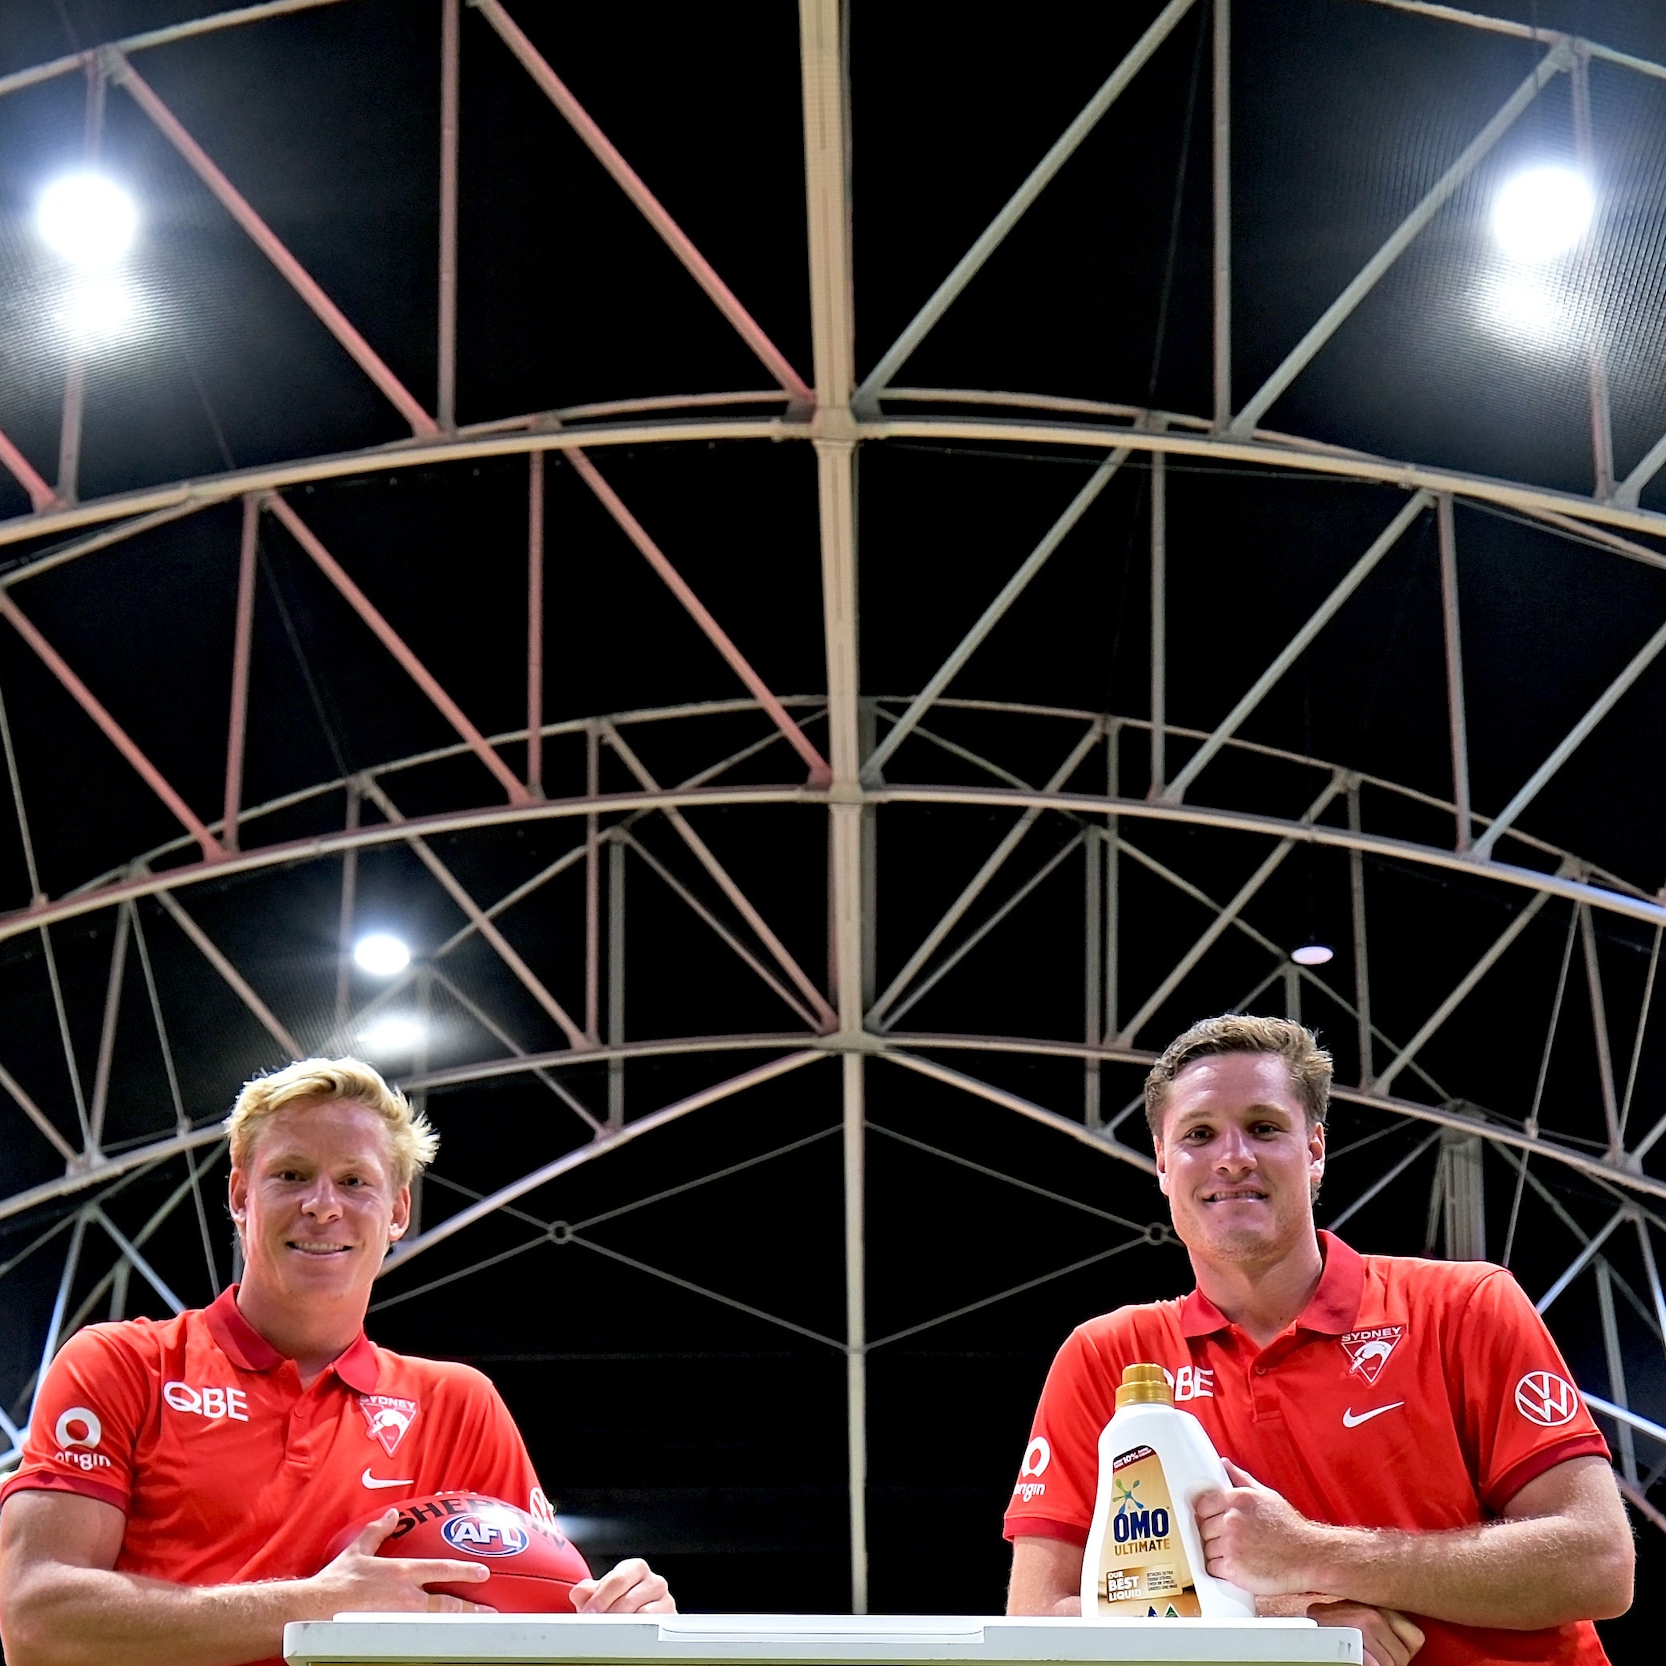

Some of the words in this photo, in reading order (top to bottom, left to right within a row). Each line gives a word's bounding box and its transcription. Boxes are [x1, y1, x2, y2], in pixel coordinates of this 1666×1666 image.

[1341, 1327, 1402, 1342] SYDNEY
[163, 1381, 249, 1422] QBE
[359, 1395, 416, 1410] SYDNEY
[54, 1450, 111, 1471] origin
[1113, 1508, 1169, 1543] OMO
[452, 1521, 522, 1548] AFL
[1114, 1539, 1171, 1556] ULTIMATE
[1107, 1570, 1124, 1580] OUR
[1108, 1576, 1139, 1592] BEST
[1108, 1588, 1142, 1602] LIQUID
